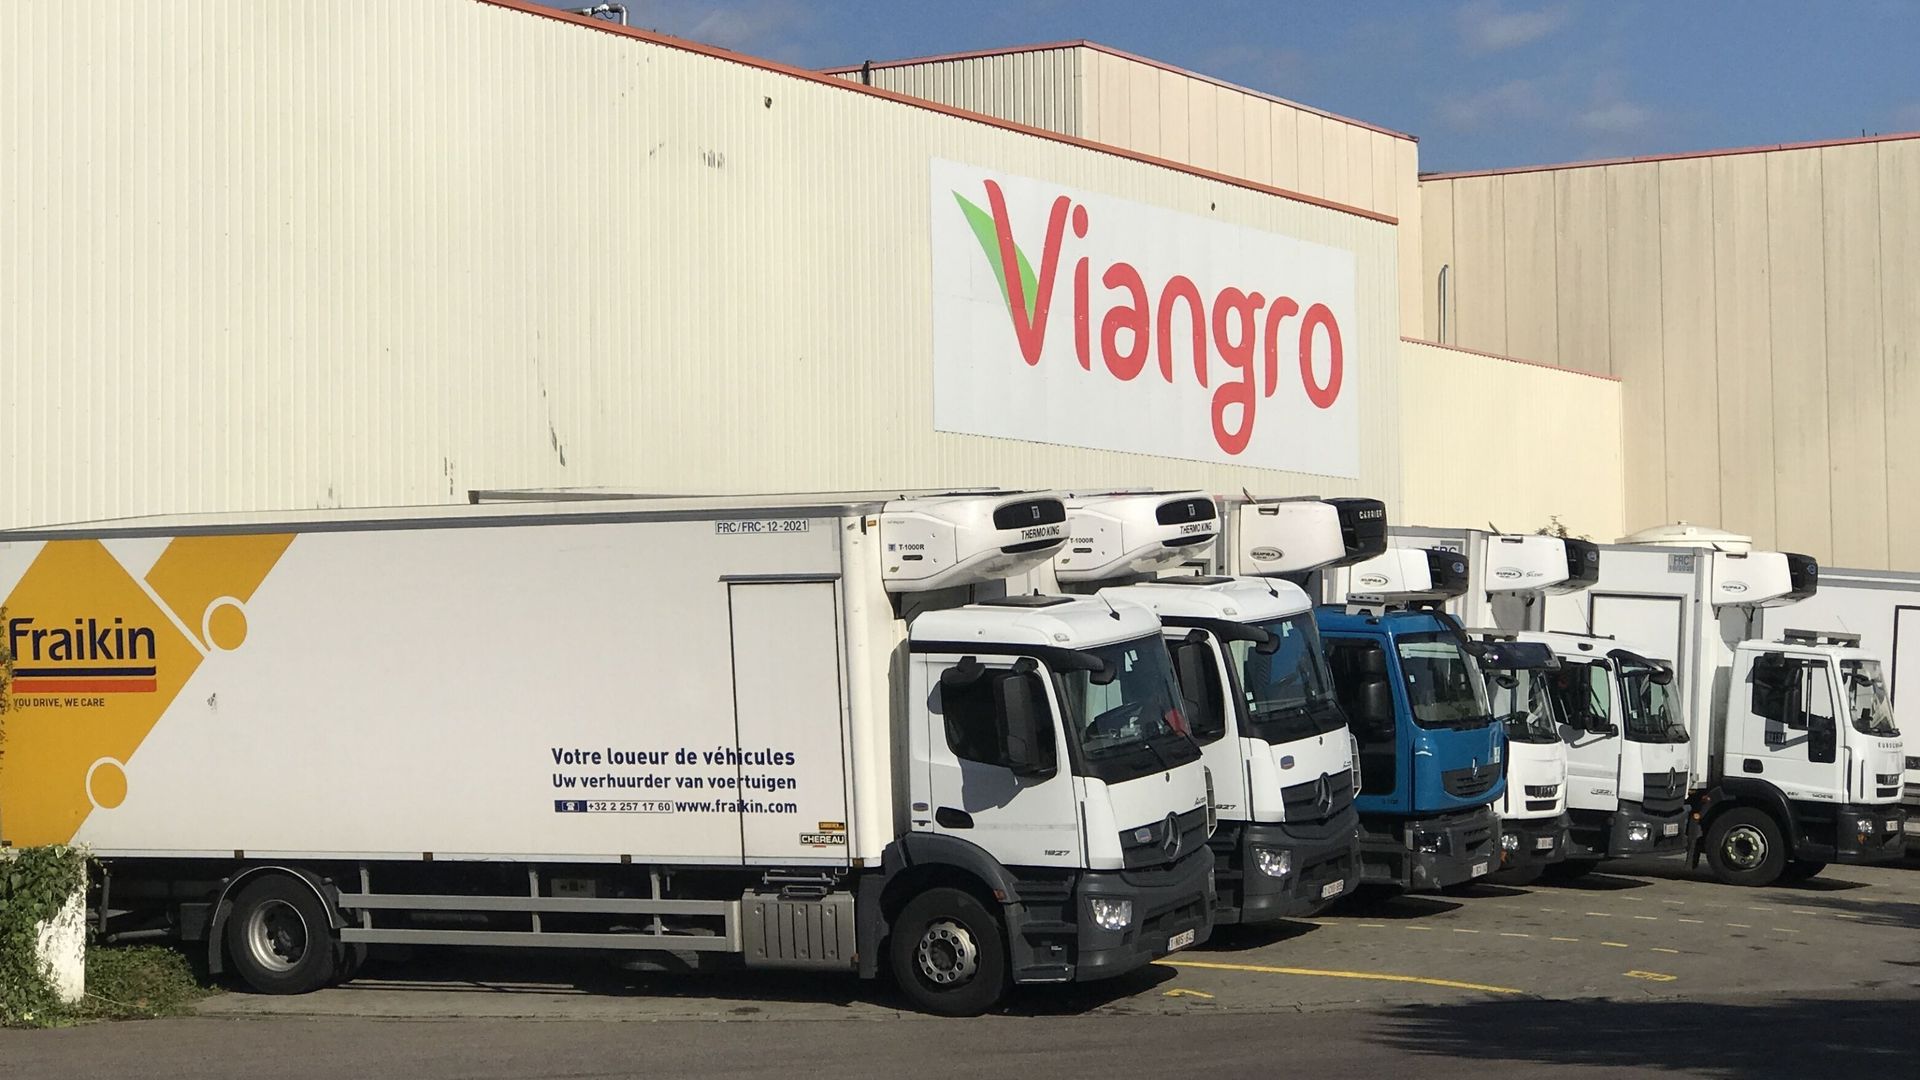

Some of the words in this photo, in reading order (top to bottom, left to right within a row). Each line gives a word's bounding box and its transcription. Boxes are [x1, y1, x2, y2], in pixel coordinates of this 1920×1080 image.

[983, 179, 1343, 455] Viangro
[1358, 510, 1383, 519] CARRIER
[1021, 527, 1046, 540] THERMO
[1046, 525, 1060, 536] KING
[1180, 524, 1200, 535] THERMO
[1201, 522, 1212, 532] KING
[9, 617, 156, 661] Fraikin
[13, 698, 30, 707] YOU
[33, 698, 62, 708] DRIVE,
[64, 698, 79, 707] WE
[81, 698, 105, 707] CARE
[551, 747, 602, 765] Votre
[607, 747, 669, 765] loueur
[675, 747, 697, 765] de
[703, 746, 796, 766] véhicules
[552, 773, 577, 788] Uw
[581, 773, 671, 788] verhuurder
[675, 776, 703, 789] van
[708, 774, 796, 792] voertuigen
[588, 802, 607, 811] +32
[610, 802, 617, 811] 2
[620, 802, 639, 811] 257
[642, 802, 655, 811] 17
[658, 802, 671, 811] 60
[675, 799, 798, 813] www.fraikin.com
[801, 835, 844, 844] CHEREAU
